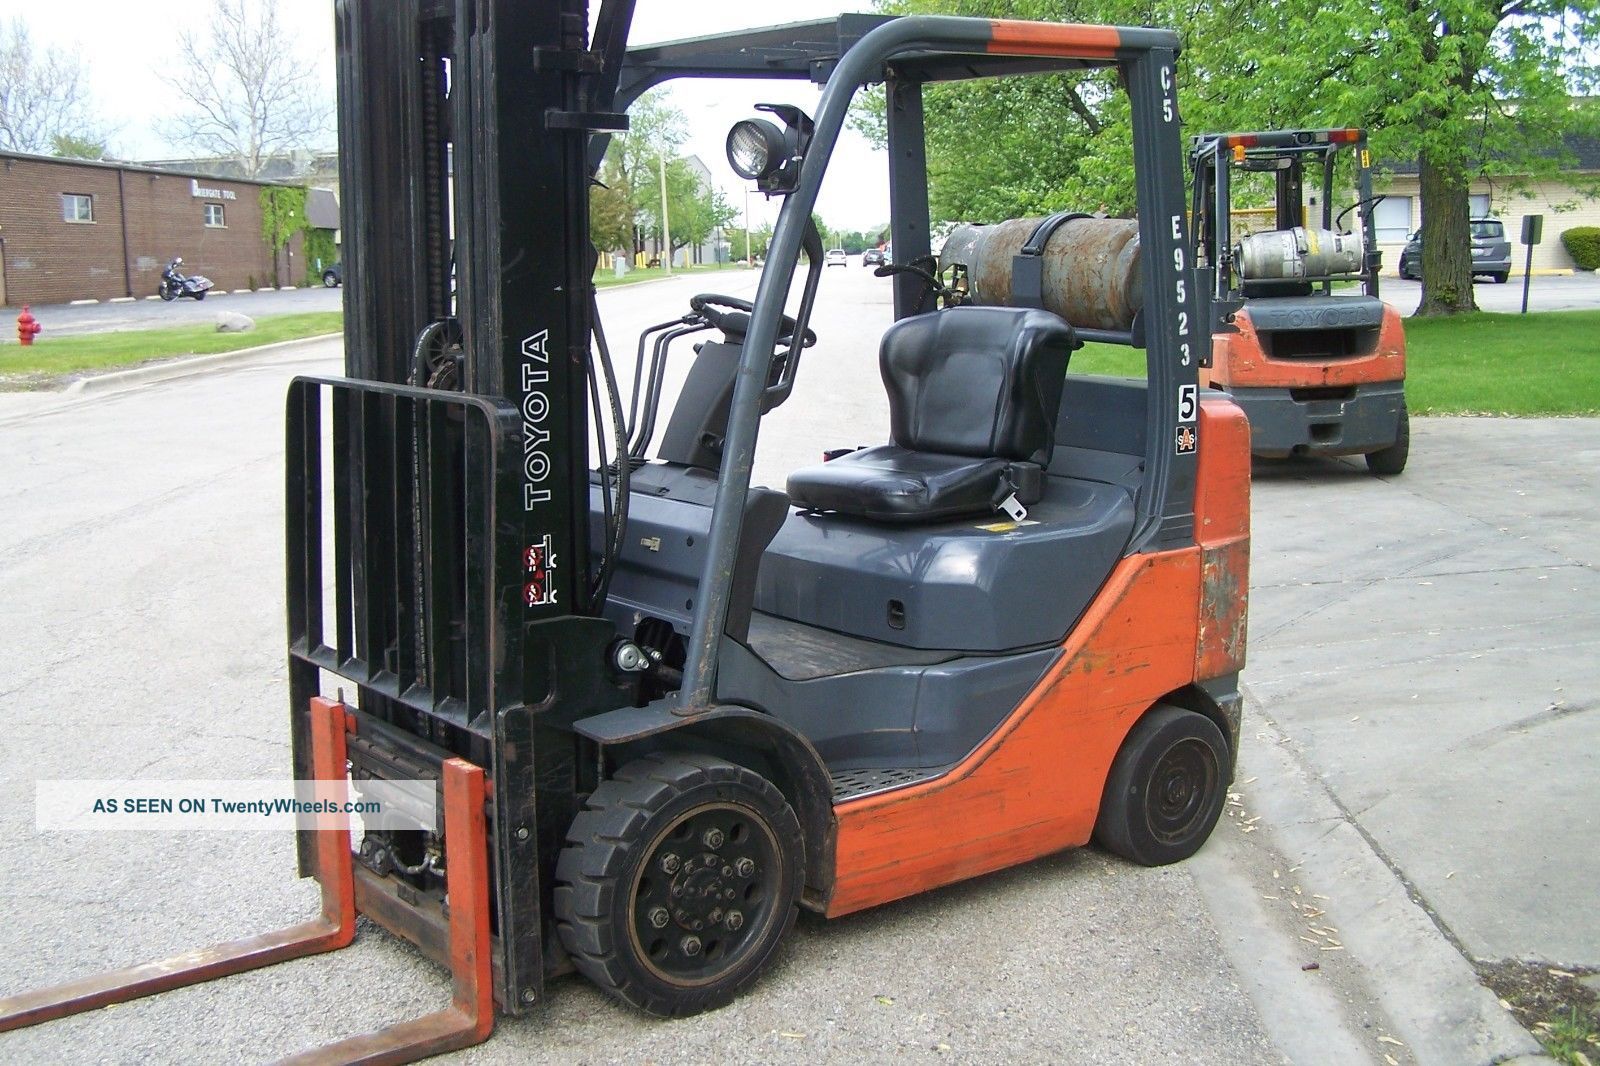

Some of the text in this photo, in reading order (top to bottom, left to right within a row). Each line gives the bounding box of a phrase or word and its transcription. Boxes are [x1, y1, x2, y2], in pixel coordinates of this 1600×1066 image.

[1171, 215, 1190, 367] E9523
[1270, 306, 1370, 328] TOYOTA
[1181, 387, 1194, 419] 5
[521, 328, 551, 512] TOYOTA
[1177, 427, 1195, 451] SAS
